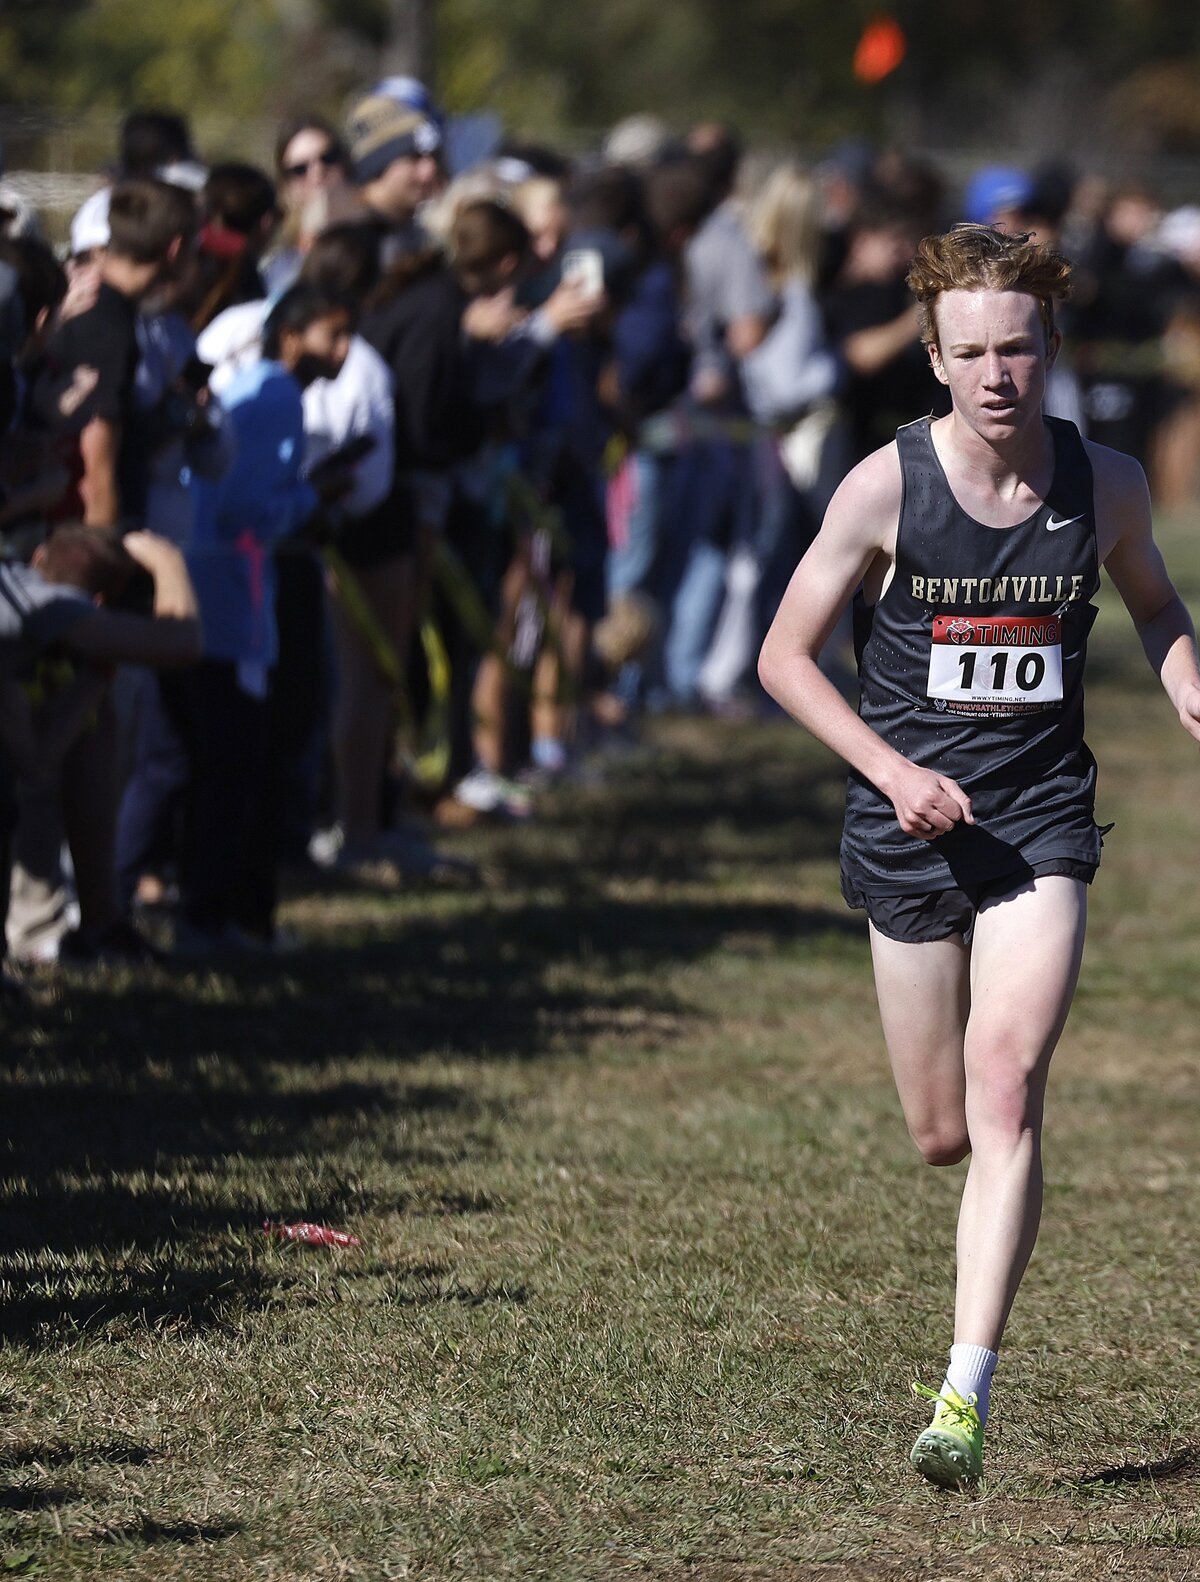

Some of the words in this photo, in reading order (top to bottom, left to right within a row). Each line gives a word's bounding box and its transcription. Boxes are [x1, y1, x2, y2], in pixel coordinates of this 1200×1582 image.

[911, 575, 1084, 604] BENTONVILLE
[977, 624, 1058, 645] TIMING
[957, 651, 1046, 692] 110
